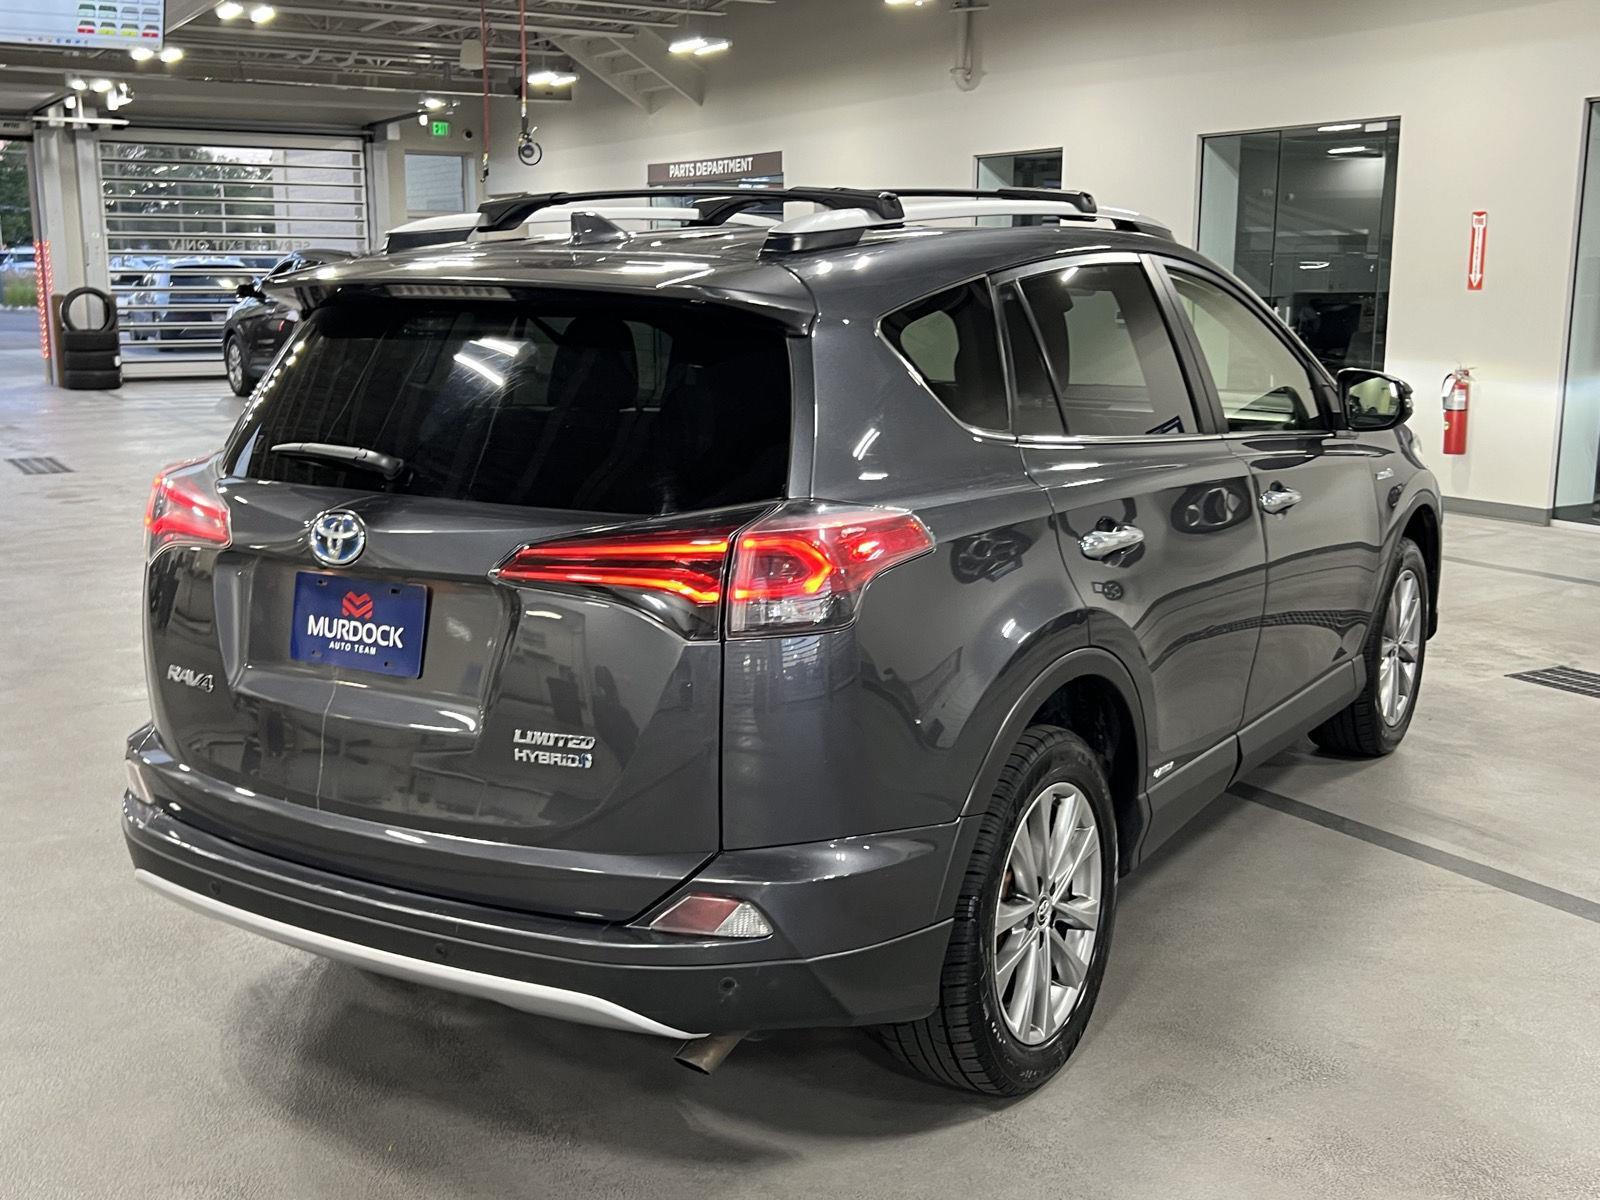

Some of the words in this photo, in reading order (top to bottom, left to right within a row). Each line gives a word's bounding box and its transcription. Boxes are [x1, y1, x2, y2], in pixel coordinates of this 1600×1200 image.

[669, 163, 695, 178] PARTS
[695, 157, 754, 176] DEPARTMENT
[307, 614, 404, 649] MURDOCK
[328, 641, 352, 652] AUTO
[354, 644, 377, 655] TEAM
[167, 664, 214, 693] RAV4
[513, 728, 596, 750] LIMITED
